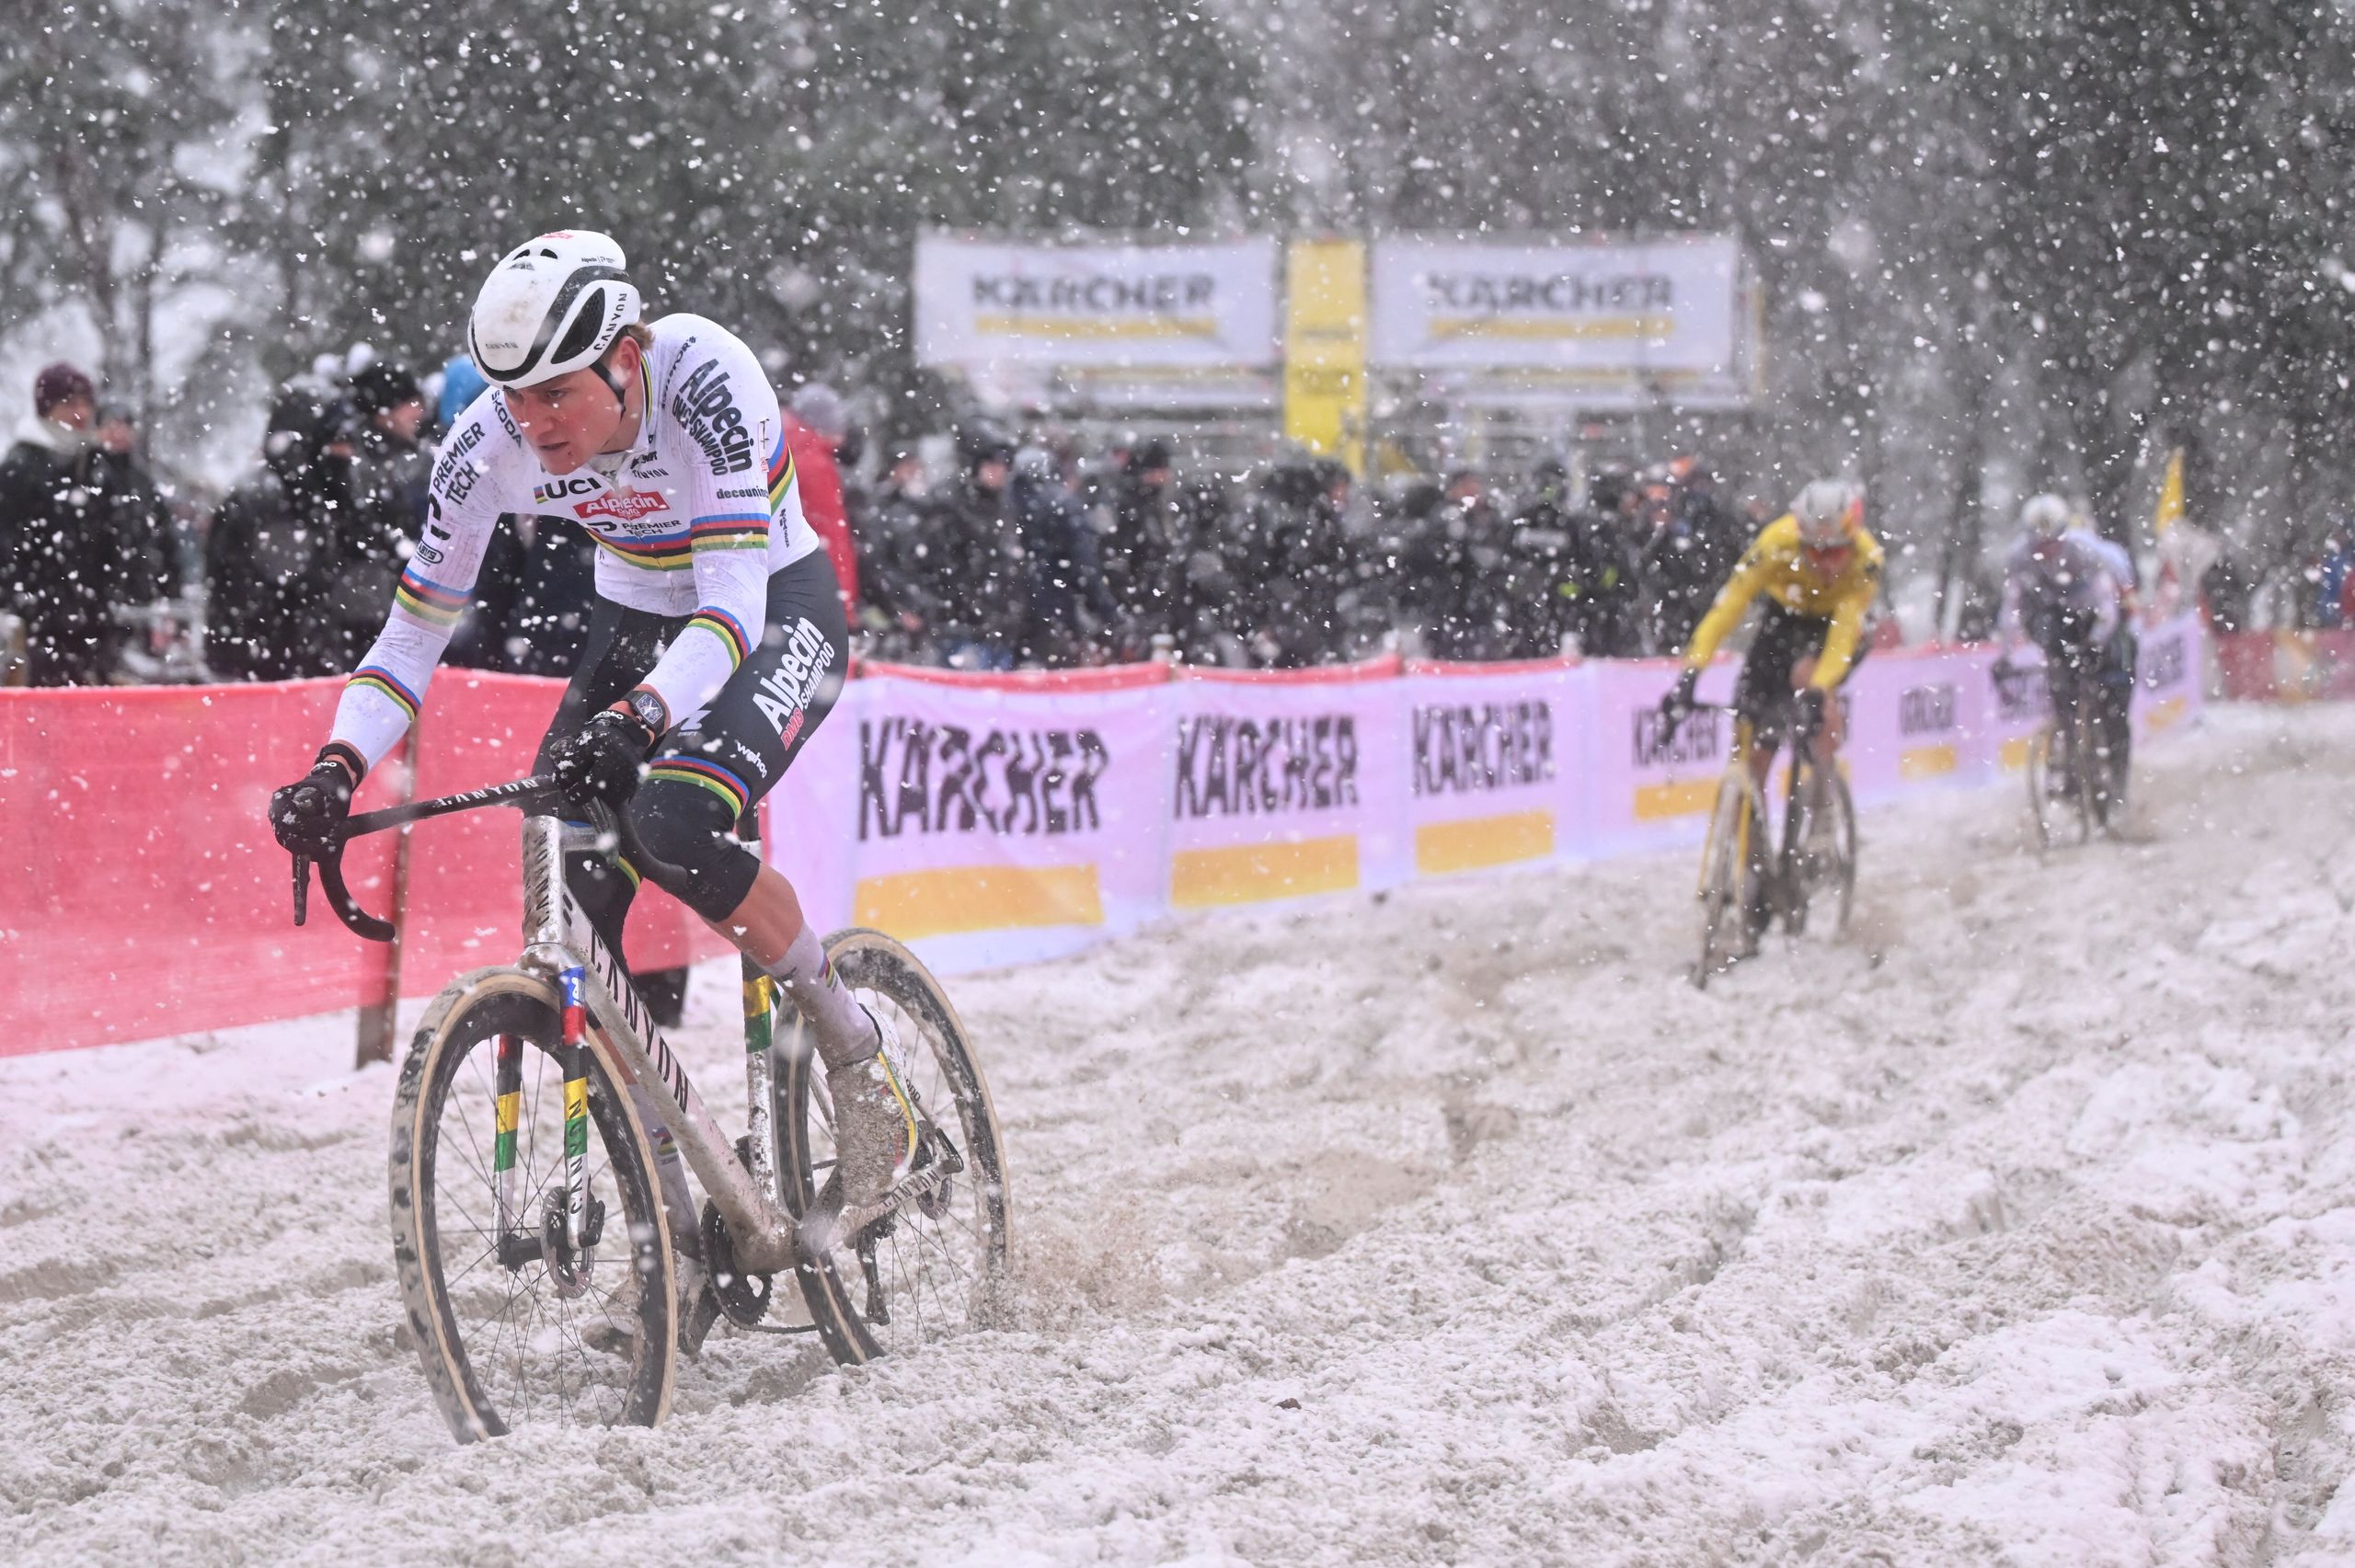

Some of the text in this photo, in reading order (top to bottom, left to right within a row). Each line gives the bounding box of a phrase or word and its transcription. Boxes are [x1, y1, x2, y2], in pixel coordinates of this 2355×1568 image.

[593, 293, 626, 350] CANYON
[679, 359, 753, 474] Alpecin
[689, 418, 729, 476] SHAMPOO
[433, 421, 486, 494] PREMIER
[445, 461, 480, 505] TECH
[545, 477, 602, 498] UCI
[586, 493, 659, 514] Alpecin
[622, 520, 682, 531] PREMIER
[752, 616, 825, 736] Alpecin
[798, 641, 835, 710] SHAMPOO
[437, 779, 540, 807] CANYON
[857, 716, 1109, 841] KÄRCHER
[591, 925, 689, 1115] CANYON
[569, 1098, 583, 1215] CANYON
